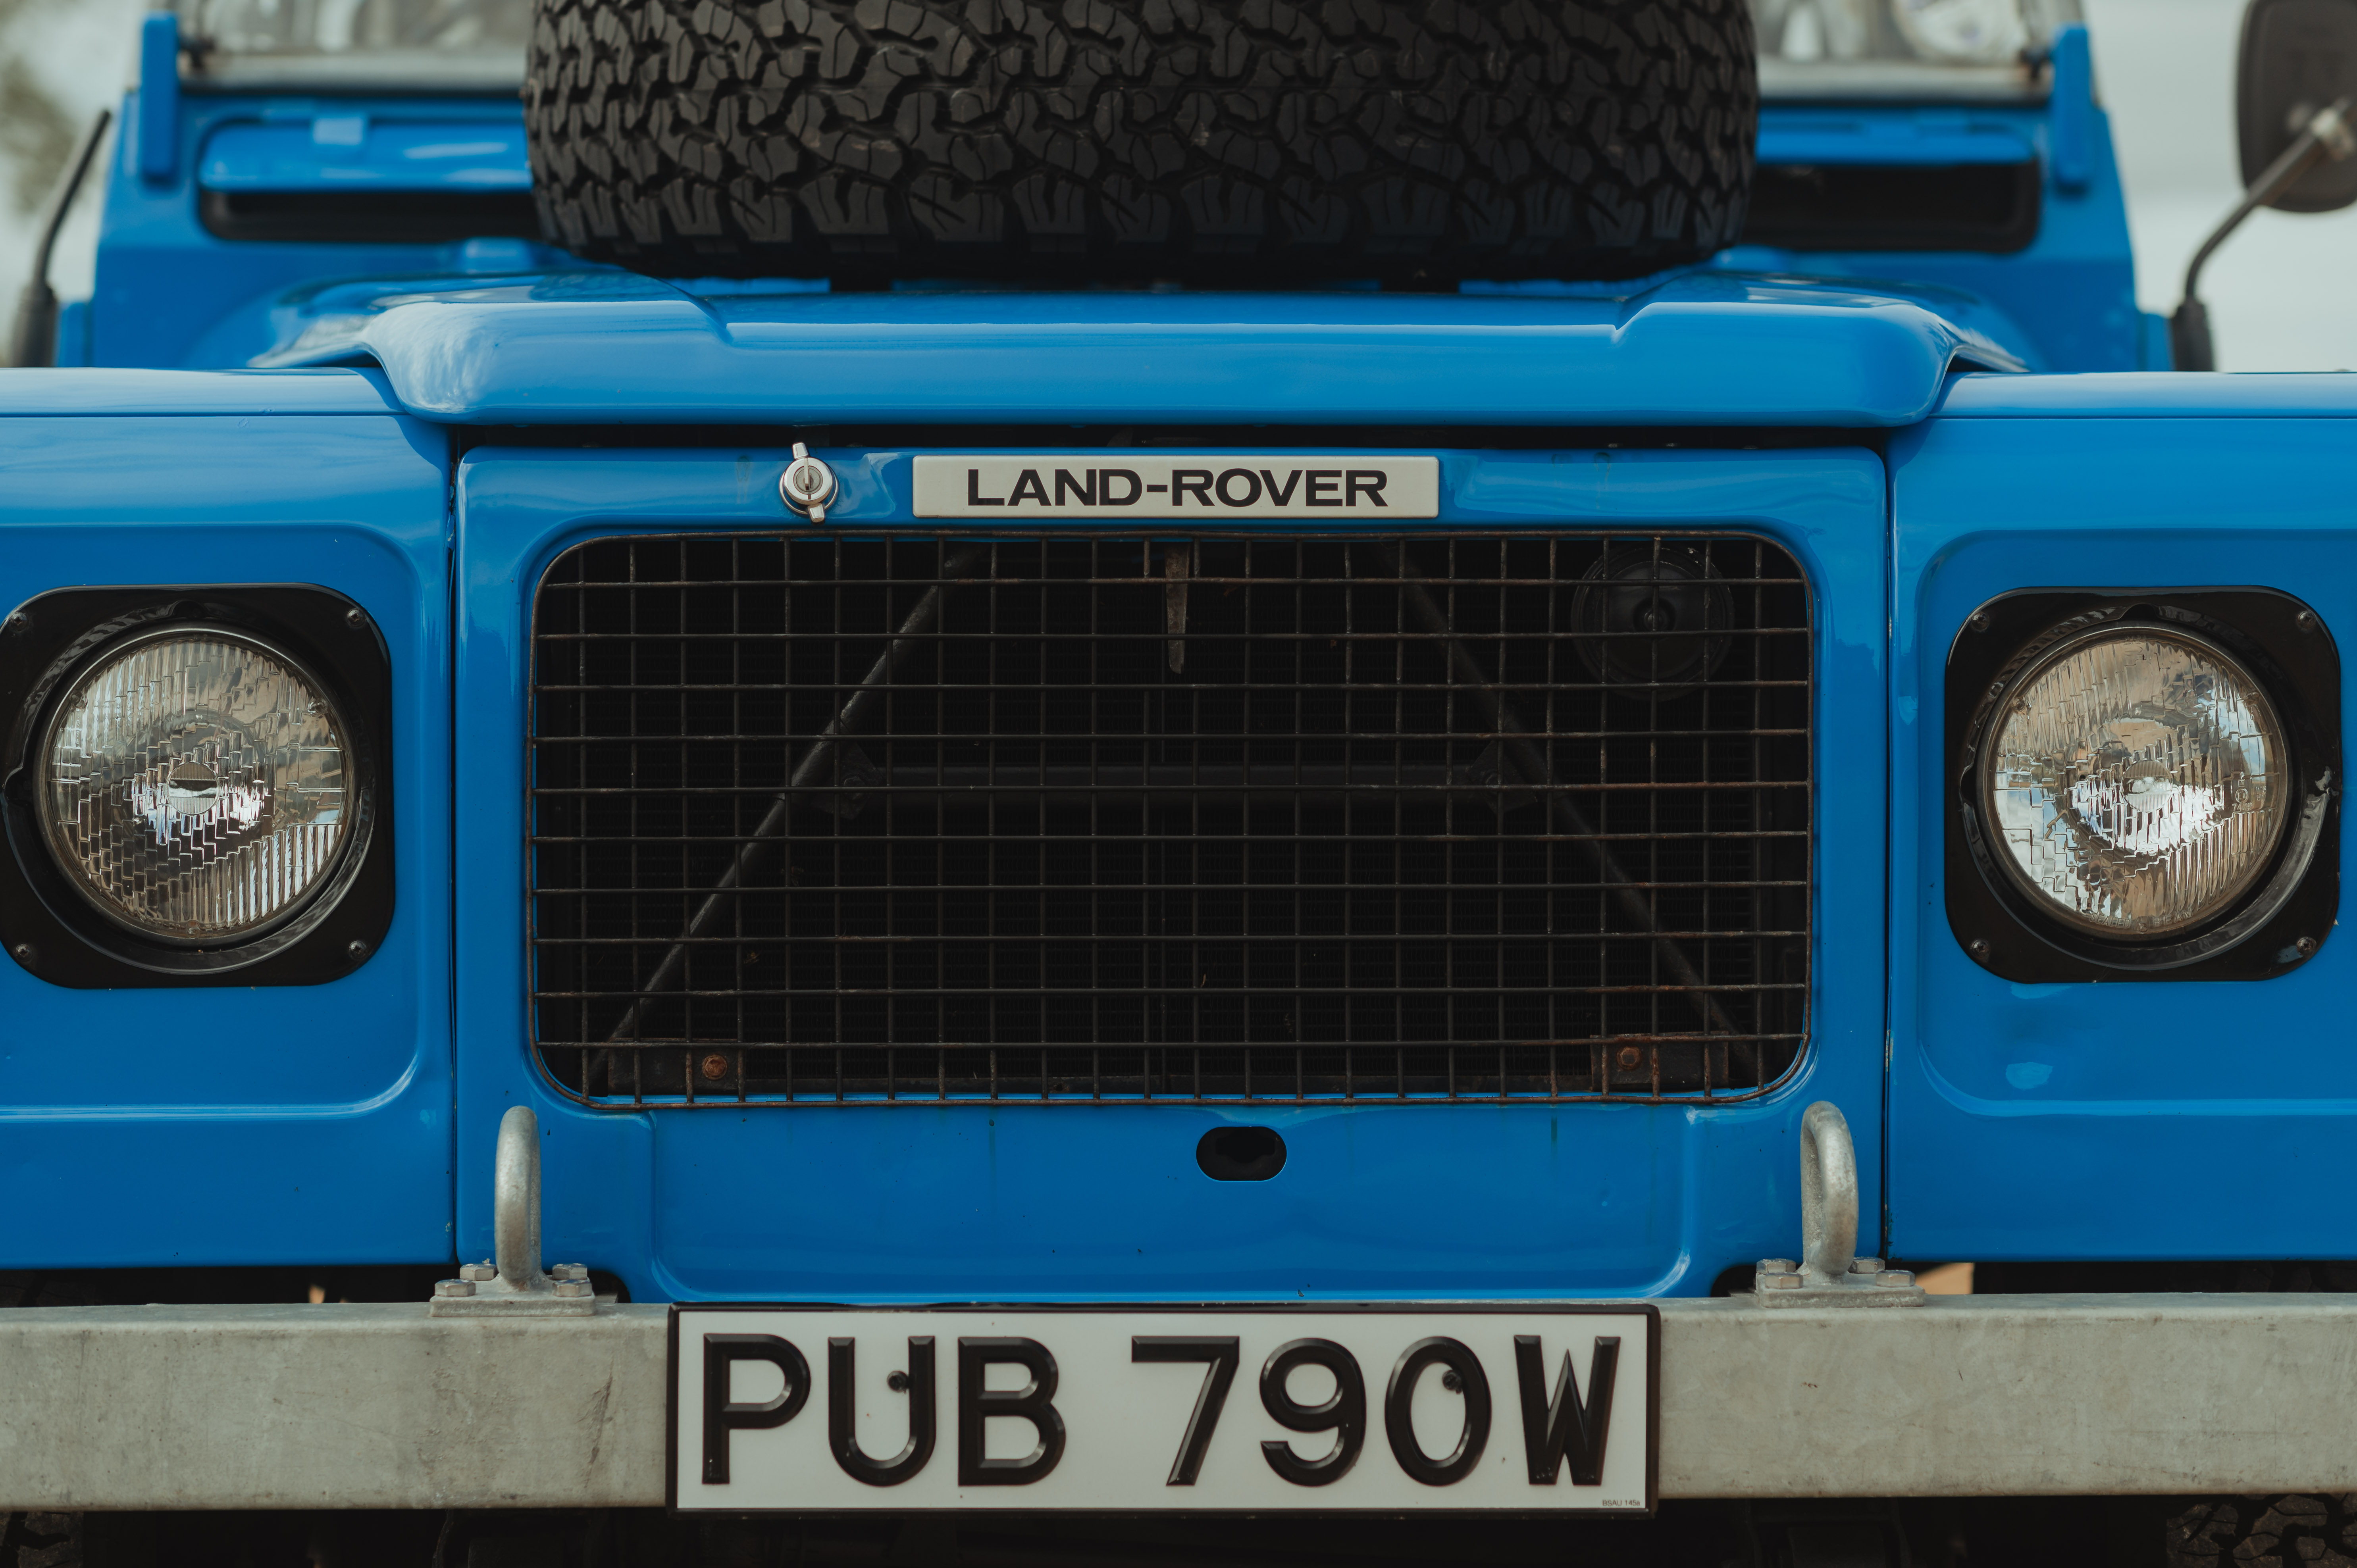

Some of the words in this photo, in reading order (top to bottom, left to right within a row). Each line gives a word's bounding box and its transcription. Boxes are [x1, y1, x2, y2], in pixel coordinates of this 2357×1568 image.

[968, 468, 1388, 507] LAND-ROVER
[2089, 913, 2131, 929] SEALED
[2153, 910, 2193, 927] BEAM
[702, 1333, 1067, 1487] PUB
[1131, 1335, 1621, 1487] 790W
